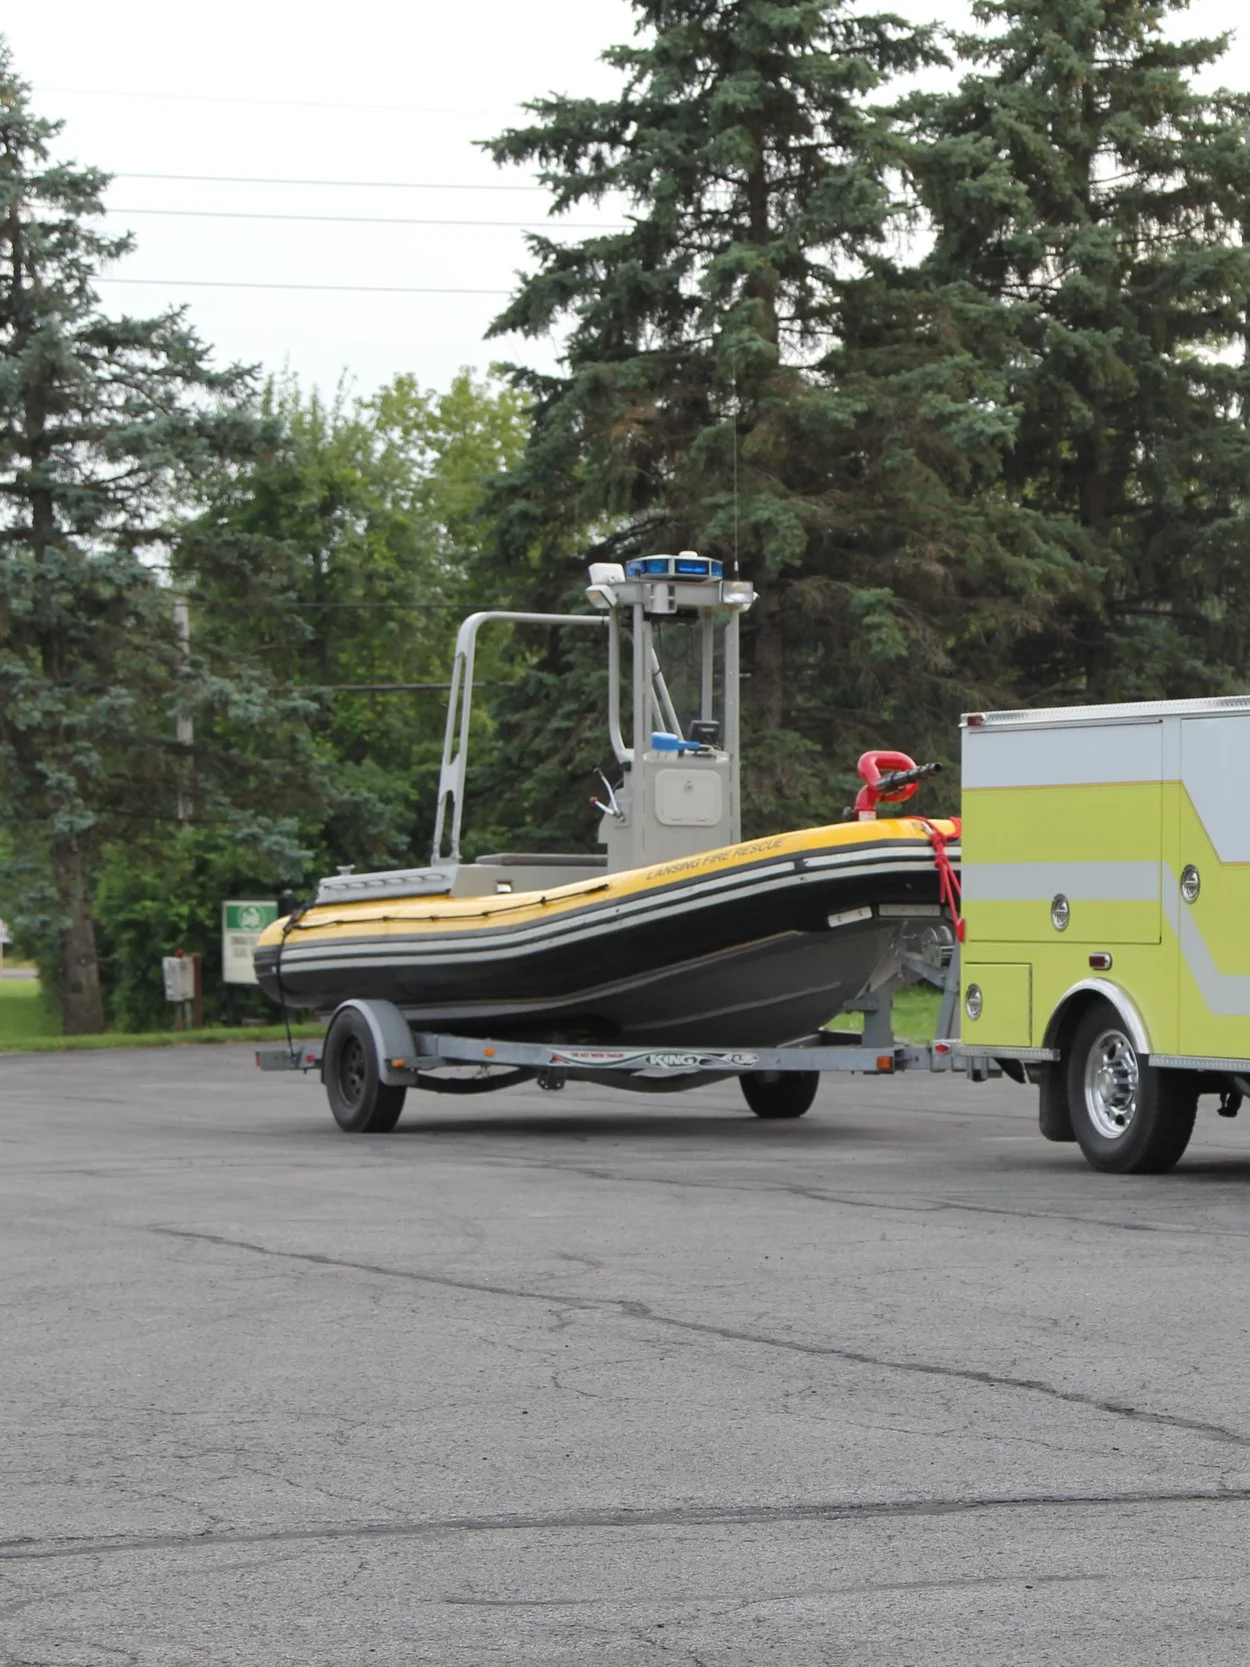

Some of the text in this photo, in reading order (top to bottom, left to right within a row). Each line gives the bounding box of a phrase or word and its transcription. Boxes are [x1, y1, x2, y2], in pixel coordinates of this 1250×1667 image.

[646, 839, 784, 880] LANSING FIRE RESCUE
[649, 1054, 696, 1069] KING
